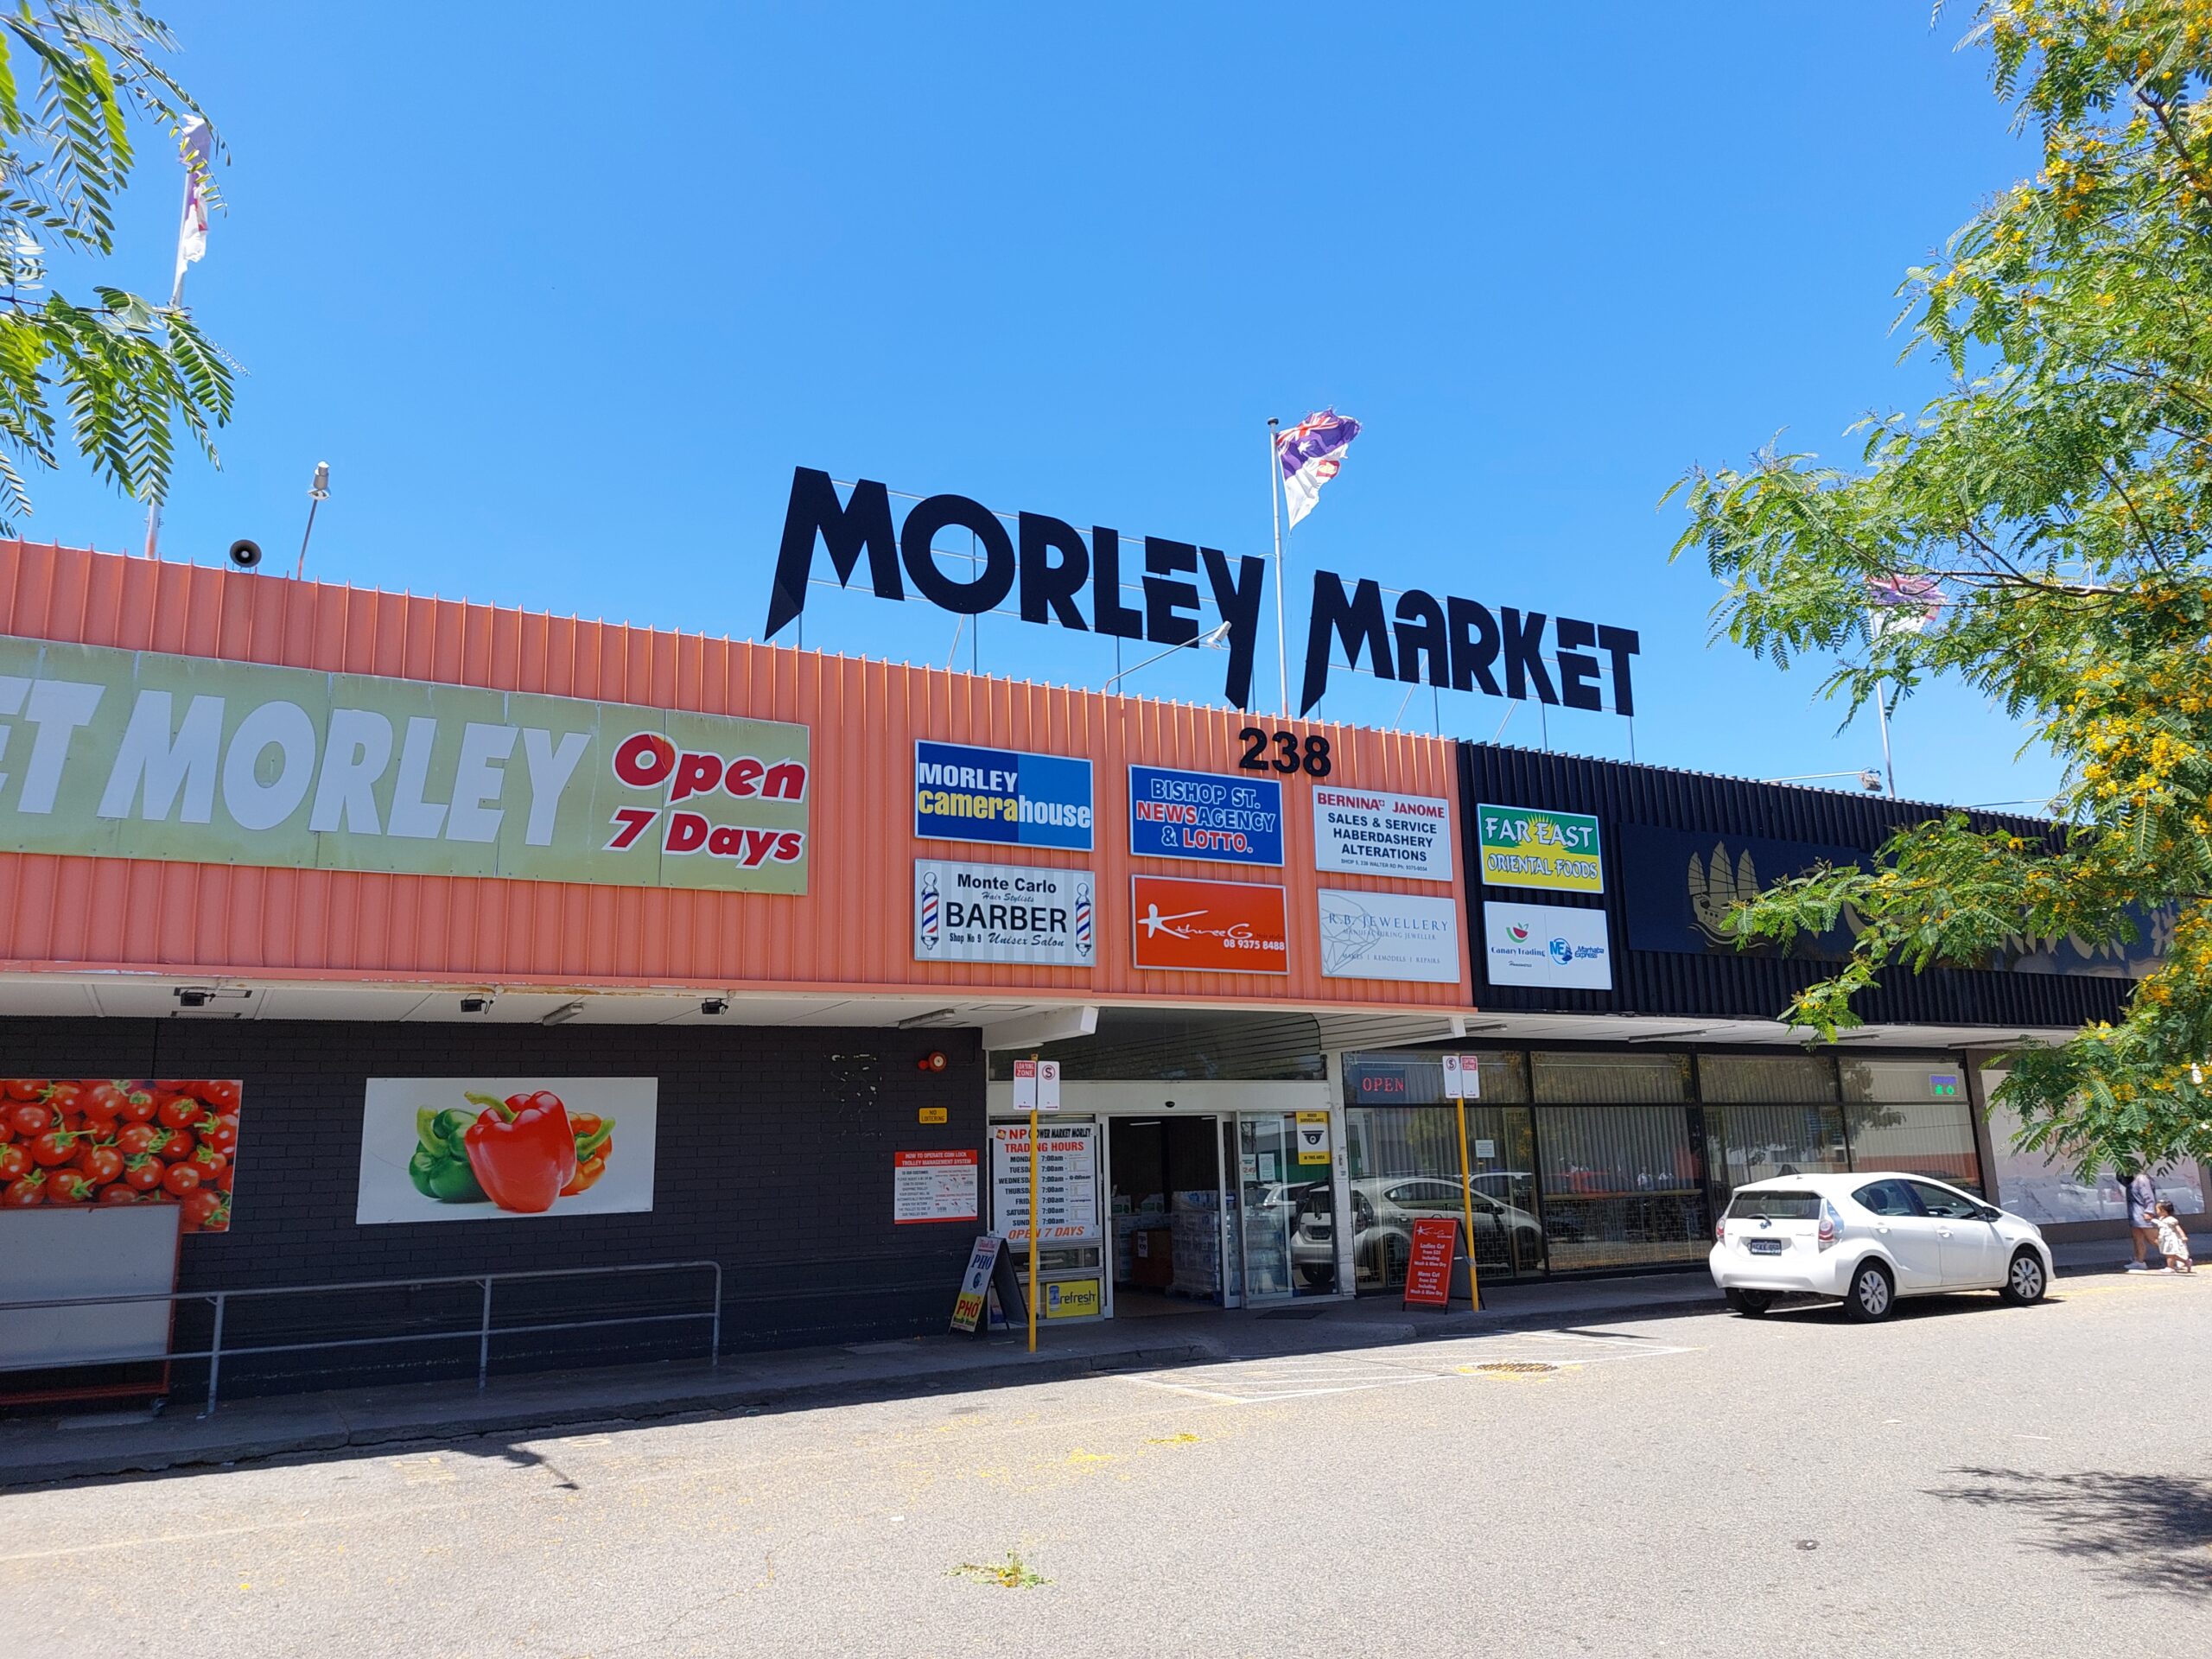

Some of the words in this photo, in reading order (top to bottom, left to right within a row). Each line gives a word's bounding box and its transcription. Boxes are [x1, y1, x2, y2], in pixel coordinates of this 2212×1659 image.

[765, 466, 1265, 709] MORLEY
[1300, 569, 1639, 717] MARKET
[1239, 728, 1331, 778] 238
[96, 690, 592, 846] MORLEY
[612, 731, 809, 807] Open
[919, 762, 1017, 792] MORLEY
[1151, 779, 1226, 804] BISHOP
[1232, 787, 1261, 809] ST.
[1318, 792, 1379, 810] BERNINA
[1392, 802, 1445, 818] JANOME
[918, 790, 1090, 828] camerahouse
[1136, 801, 1275, 832] NEWSAGENCY
[1328, 812, 1368, 826] SALES
[1372, 817, 1381, 827] &
[1386, 819, 1437, 834] SERVICE
[1484, 817, 1532, 842] FAR
[1533, 822, 1592, 849] EAST
[602, 805, 662, 851] 7
[662, 810, 806, 869] Days
[1161, 826, 1178, 847] &
[1183, 829, 1253, 854] LOTTO.
[1333, 828, 1433, 848] HABERDASHERY
[1342, 843, 1427, 861] ALTERATIONS
[1488, 854, 1553, 875] ORIENTAL
[1555, 859, 1598, 879] FOODS
[957, 874, 1008, 890] Monte
[1014, 878, 1057, 893] Carlo
[982, 892, 1001, 900] Hair
[1004, 893, 1034, 902] Stylists
[946, 902, 1067, 933] BARBER
[1329, 913, 1355, 925] R.B.
[1363, 915, 1448, 931] JEWELLERY
[950, 932, 964, 944] Shop
[968, 934, 975, 943] No
[977, 934, 982, 943] 9
[988, 932, 1027, 945] Unisex
[1031, 935, 1065, 947] Salon
[1224, 938, 1236, 948] 08
[1237, 939, 1260, 949] 9375
[1262, 940, 1285, 950] 8488
[1404, 931, 1437, 940] JEWELLER
[1362, 1077, 1404, 1092] OPEN
[1009, 1128, 1027, 1140] NP
[1052, 1128, 1071, 1138] MARKET
[1071, 1128, 1090, 1137] MORLEY
[1005, 1142, 1047, 1153] TRADNG
[1051, 1141, 1084, 1151] HOURS
[1045, 1228, 1052, 1237] 7
[1055, 1226, 1084, 1236] DAYS
[1060, 1290, 1096, 1305] refresh
